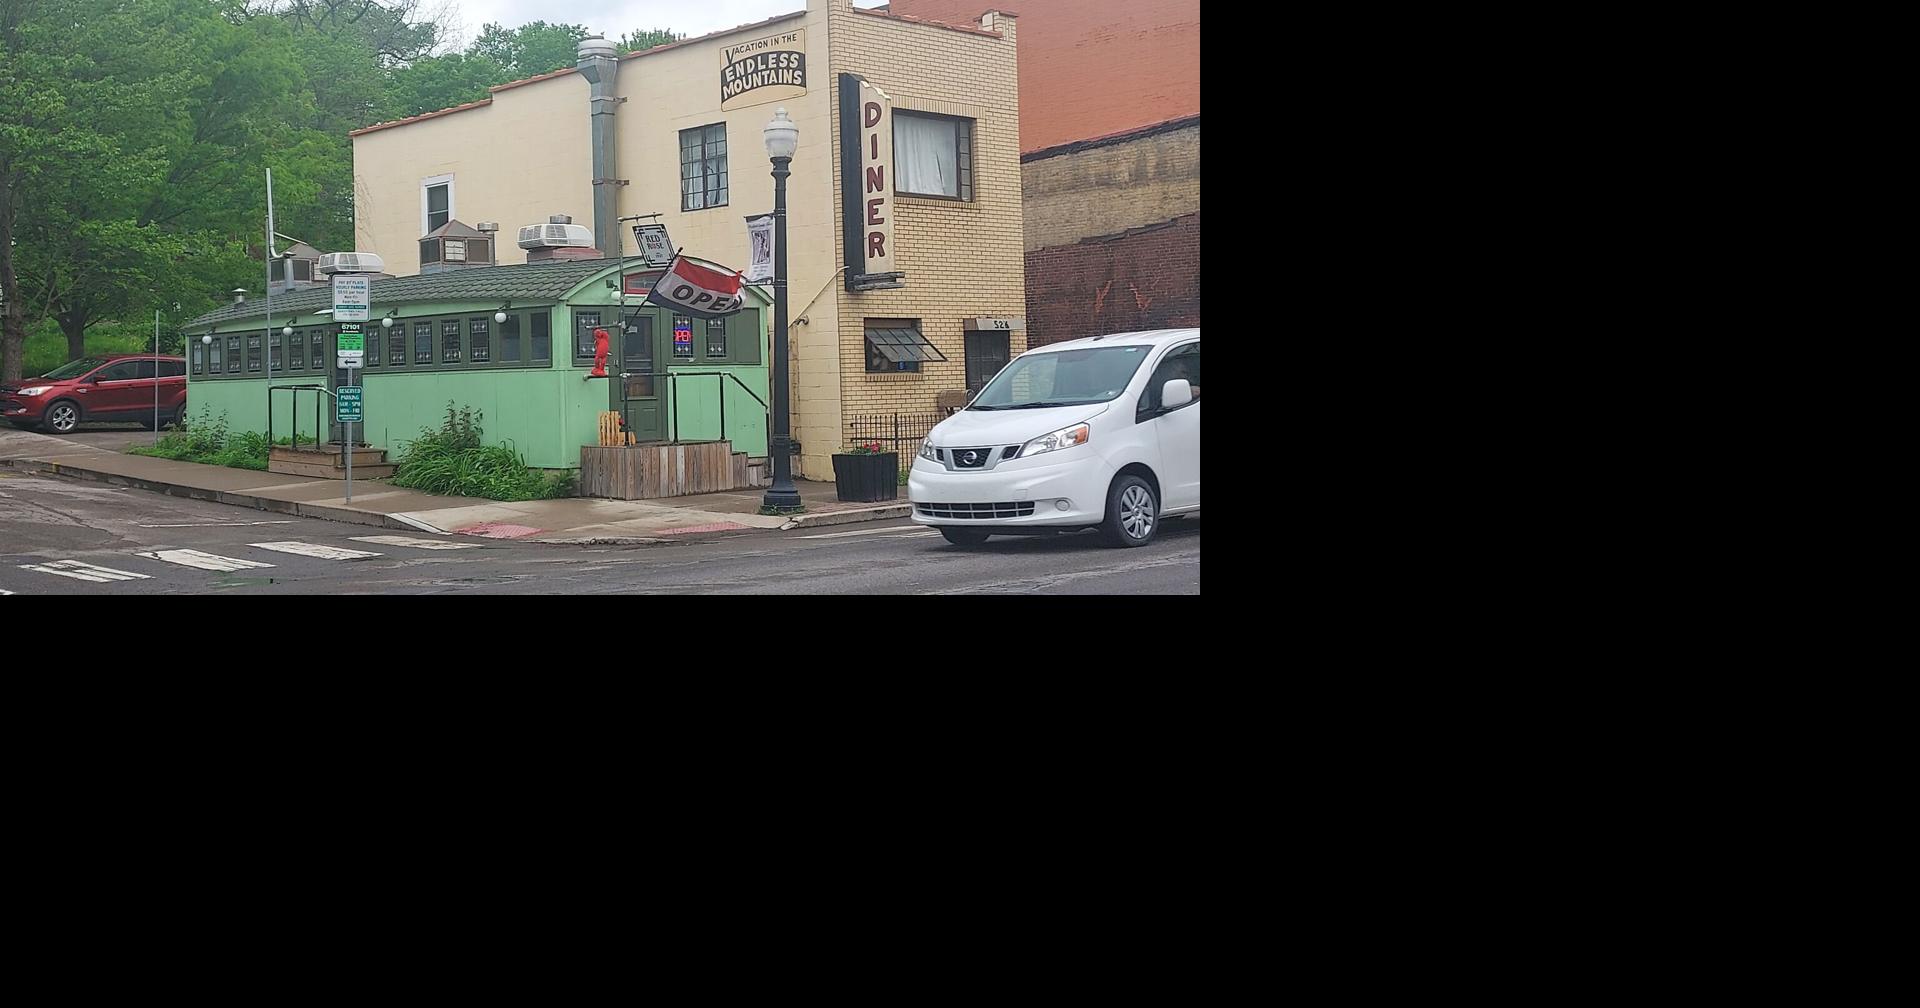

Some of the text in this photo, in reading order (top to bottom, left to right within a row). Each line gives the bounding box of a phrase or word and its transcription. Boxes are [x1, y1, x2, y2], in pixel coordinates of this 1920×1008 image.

[725, 33, 797, 65] VACATION IN THE
[725, 53, 800, 82] ENDLESS
[722, 69, 803, 100] MOUNTAINS
[864, 101, 886, 259] DINER
[645, 234, 661, 243] RED
